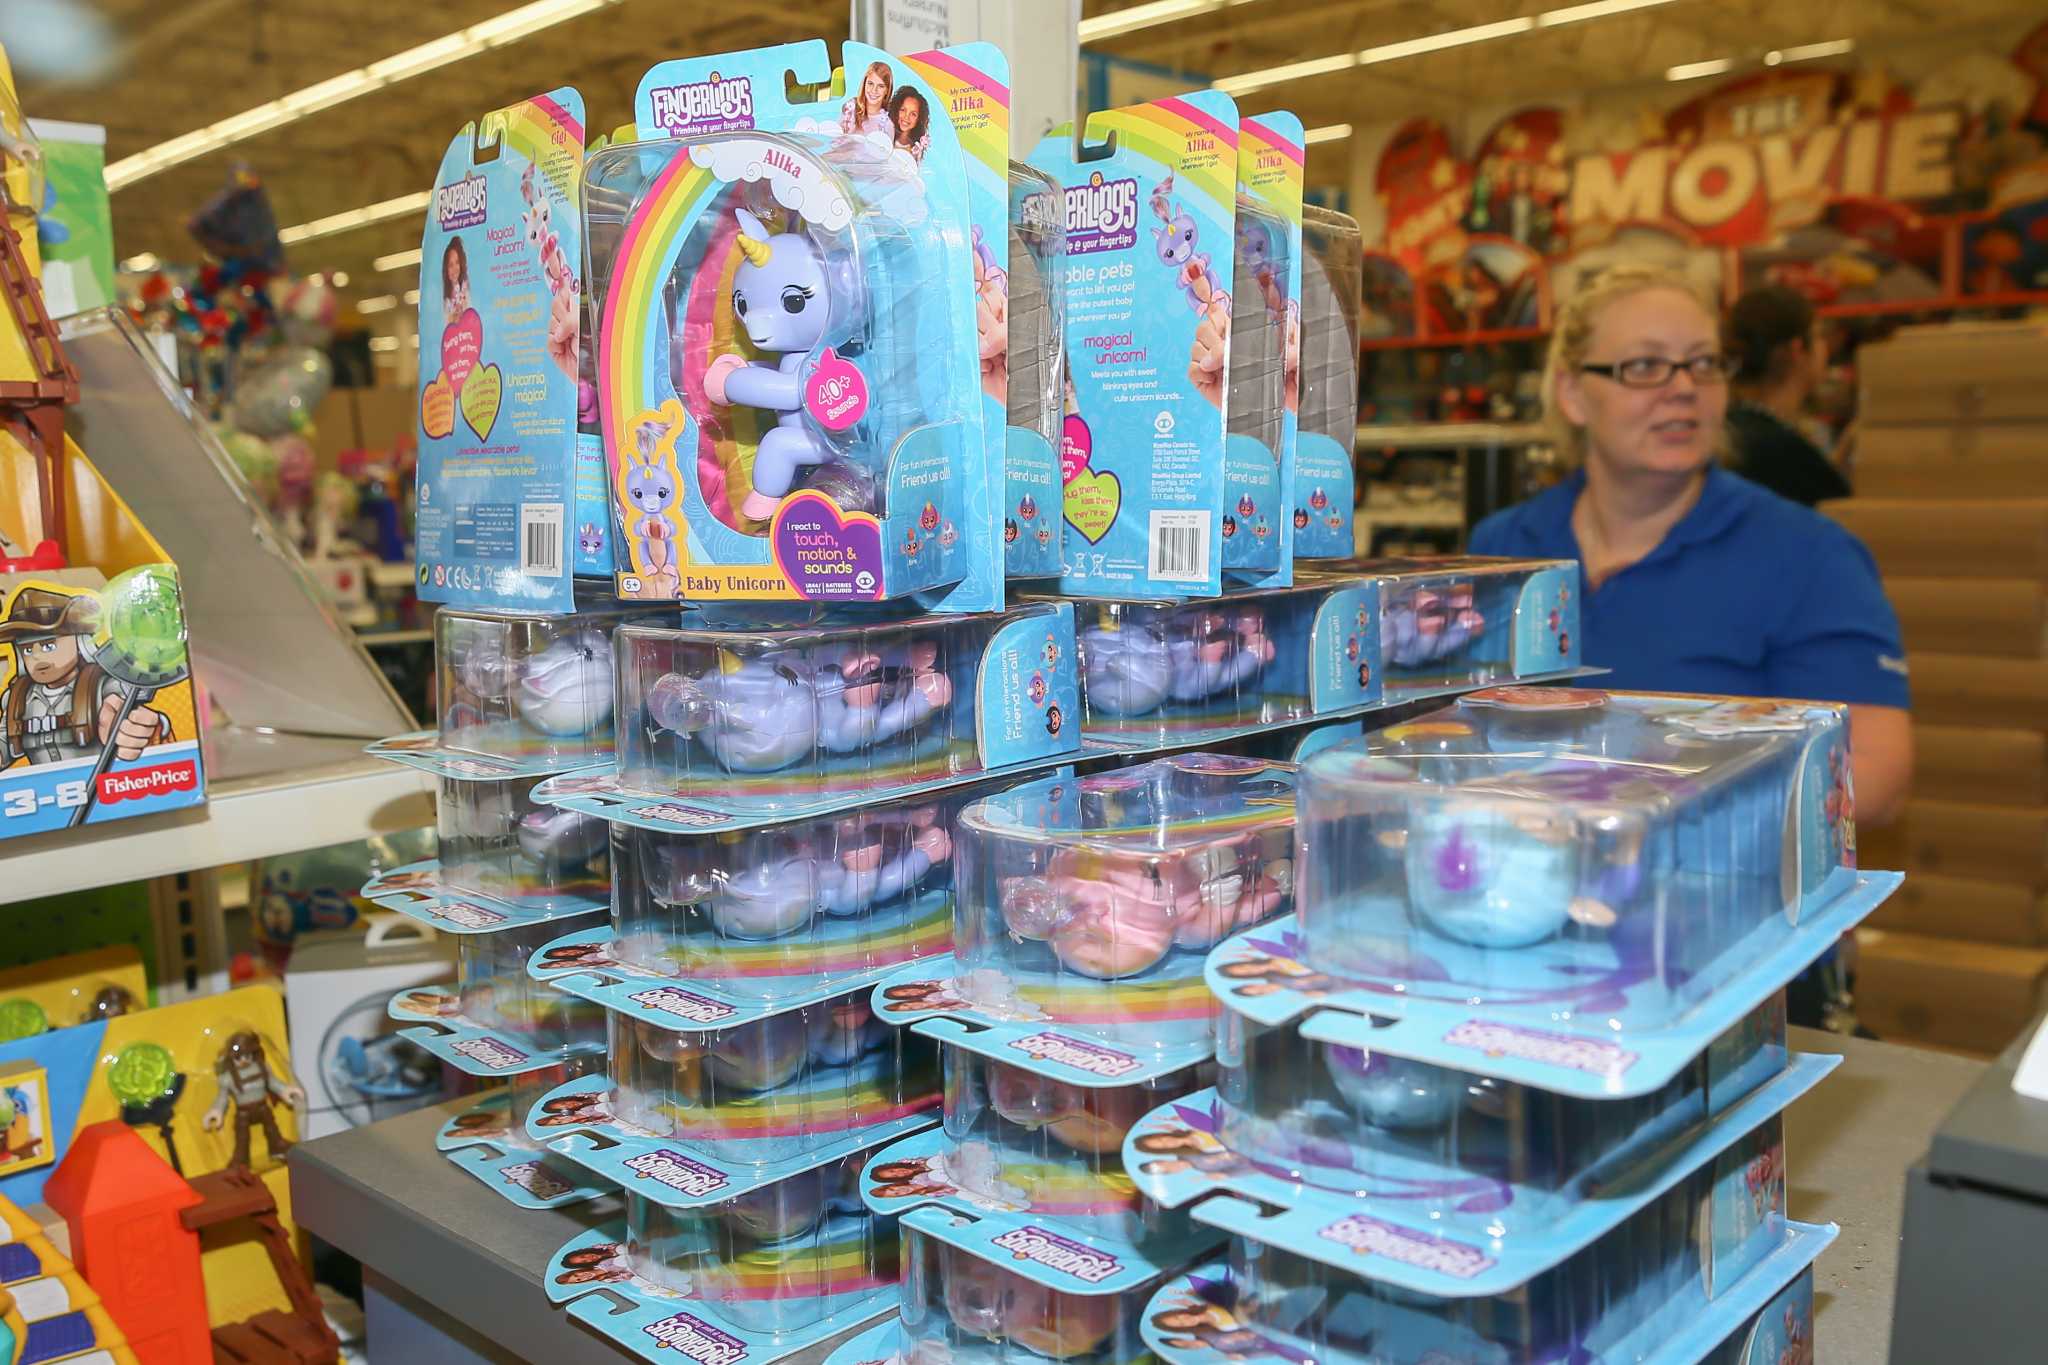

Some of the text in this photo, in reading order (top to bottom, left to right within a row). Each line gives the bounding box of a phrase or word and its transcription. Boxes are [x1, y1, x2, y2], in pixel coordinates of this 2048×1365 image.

[950, 88, 959, 97] My
[951, 96, 984, 112] Alika
[674, 124, 702, 136] friendship
[709, 122, 722, 134] your
[723, 119, 751, 131] fingertips
[1185, 139, 1215, 153] Alika
[763, 148, 801, 178] Alika
[1256, 156, 1282, 170] Alika
[1570, 111, 1960, 227] MOVIE
[486, 223, 516, 243] Magical
[1083, 239, 1097, 252] your
[1099, 234, 1132, 249] fingertips
[1099, 260, 1134, 284] pets
[1106, 284, 1121, 296] you
[1084, 330, 1133, 350] magical
[1096, 347, 1147, 365] unicorn!
[1111, 370, 1123, 379] you
[1124, 368, 1137, 378] with
[1138, 367, 1158, 377] sweet
[817, 375, 851, 406] 40+
[1144, 380, 1158, 389] and
[1129, 392, 1154, 402] unicorn
[901, 473, 927, 489] Friend
[928, 471, 939, 482] us
[1029, 472, 1039, 482] us
[791, 523, 811, 532] react
[811, 523, 821, 531] to
[795, 531, 839, 548] touch,
[798, 546, 857, 561] motion &
[804, 561, 853, 575] sounds
[625, 579, 638, 590] 5+
[687, 576, 786, 593] Baby Unicorn
[1008, 650, 1023, 739] Friend us all!
[105, 769, 191, 795] Fisher-Price
[4, 779, 88, 817] 3-8
